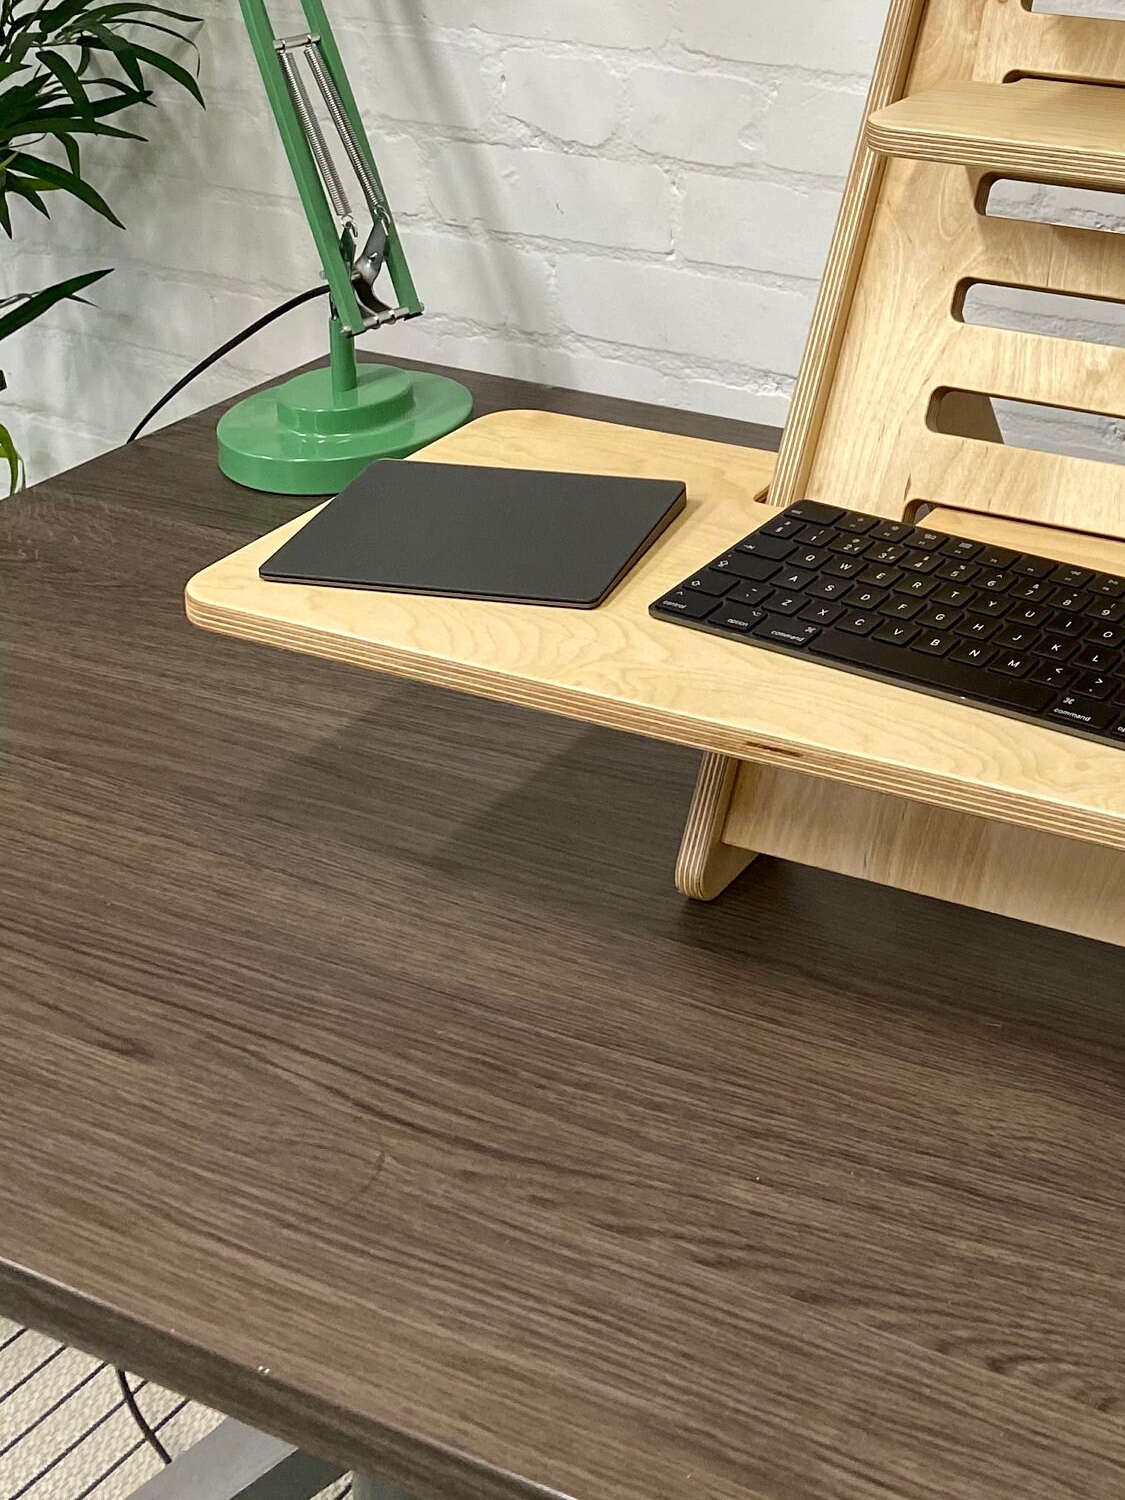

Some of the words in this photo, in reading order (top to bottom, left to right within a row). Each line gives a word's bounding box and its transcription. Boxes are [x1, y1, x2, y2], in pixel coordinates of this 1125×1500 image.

[663, 600, 687, 610] control
[727, 618, 748, 627] option
[771, 630, 805, 643] command
[1053, 707, 1092, 722] command
